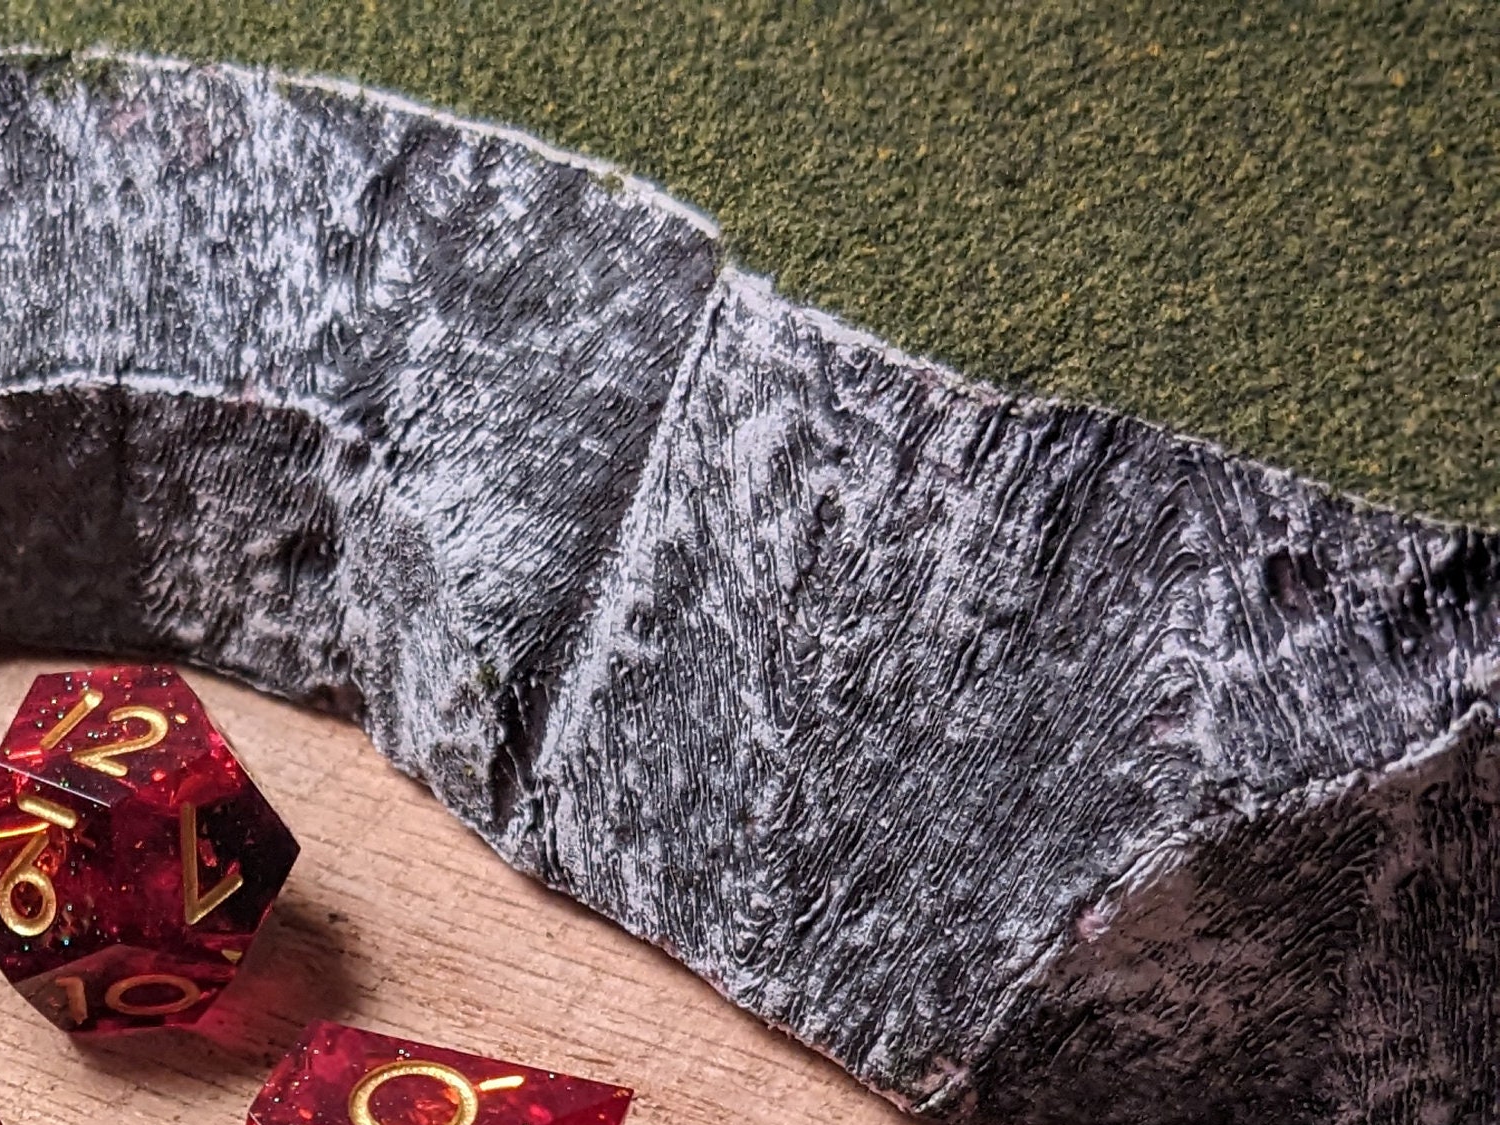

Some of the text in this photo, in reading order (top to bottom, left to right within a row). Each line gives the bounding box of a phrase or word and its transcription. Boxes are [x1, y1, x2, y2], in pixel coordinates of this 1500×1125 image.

[39, 690, 169, 777] 12
[180, 803, 243, 925] 7
[55, 973, 202, 1025] 10
